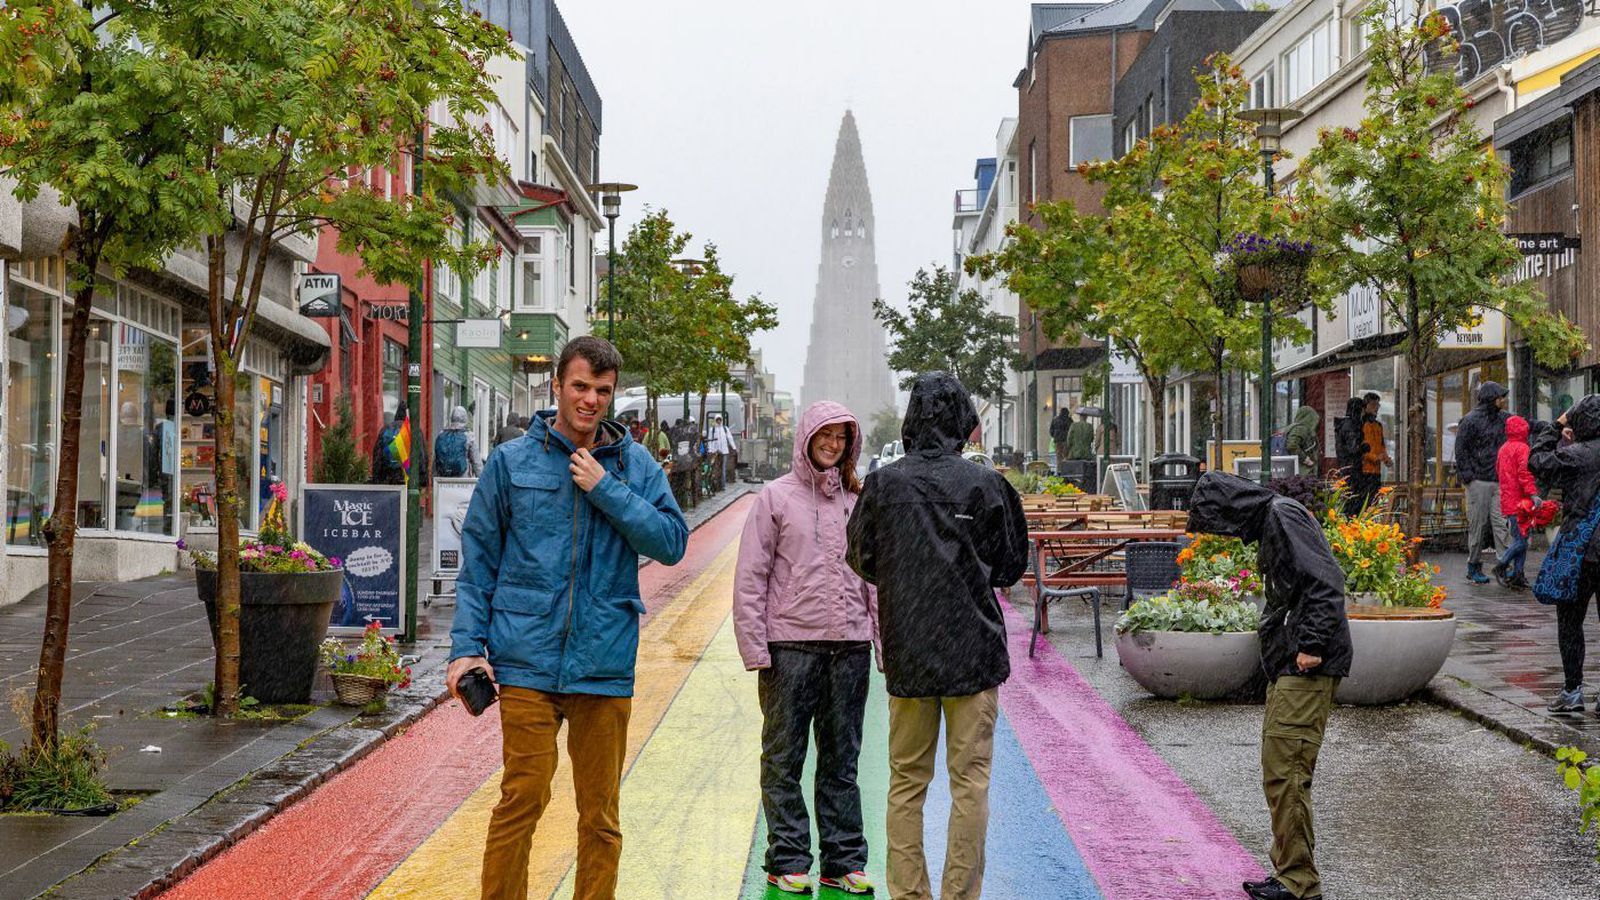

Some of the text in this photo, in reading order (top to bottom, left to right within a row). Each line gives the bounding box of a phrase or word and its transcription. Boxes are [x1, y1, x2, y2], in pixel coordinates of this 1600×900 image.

[1539, 238, 1559, 249] art
[304, 278, 333, 289] ATM
[461, 328, 496, 337] Kaolin
[333, 500, 374, 513] Magic
[341, 511, 373, 526] ICE
[324, 529, 383, 538] ICEBAR
